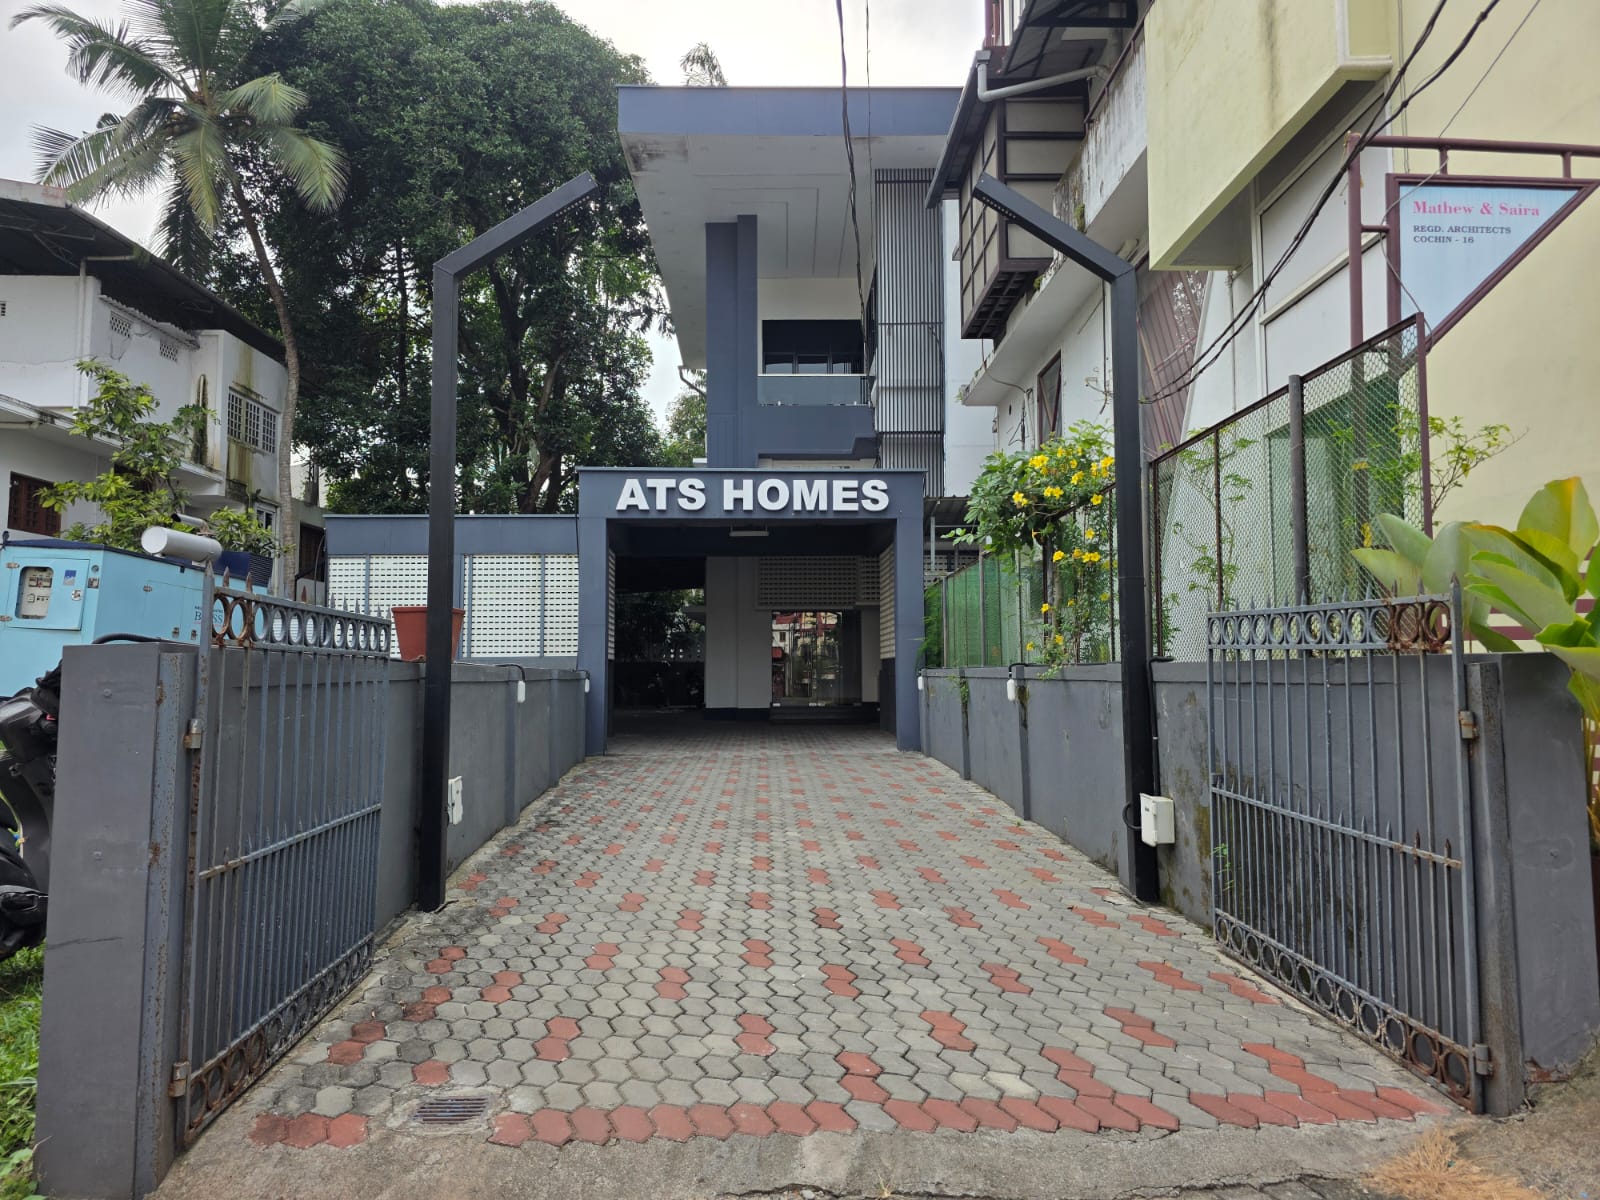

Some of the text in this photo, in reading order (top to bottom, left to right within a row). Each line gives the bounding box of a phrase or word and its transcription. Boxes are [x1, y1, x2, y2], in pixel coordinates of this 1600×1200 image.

[1413, 200, 1540, 216] Mathew & Saira
[1413, 225, 1511, 234] REGD. ARCHITECTS
[1413, 235, 1452, 243] COCHIN
[615, 478, 890, 511] ATS HOMES
